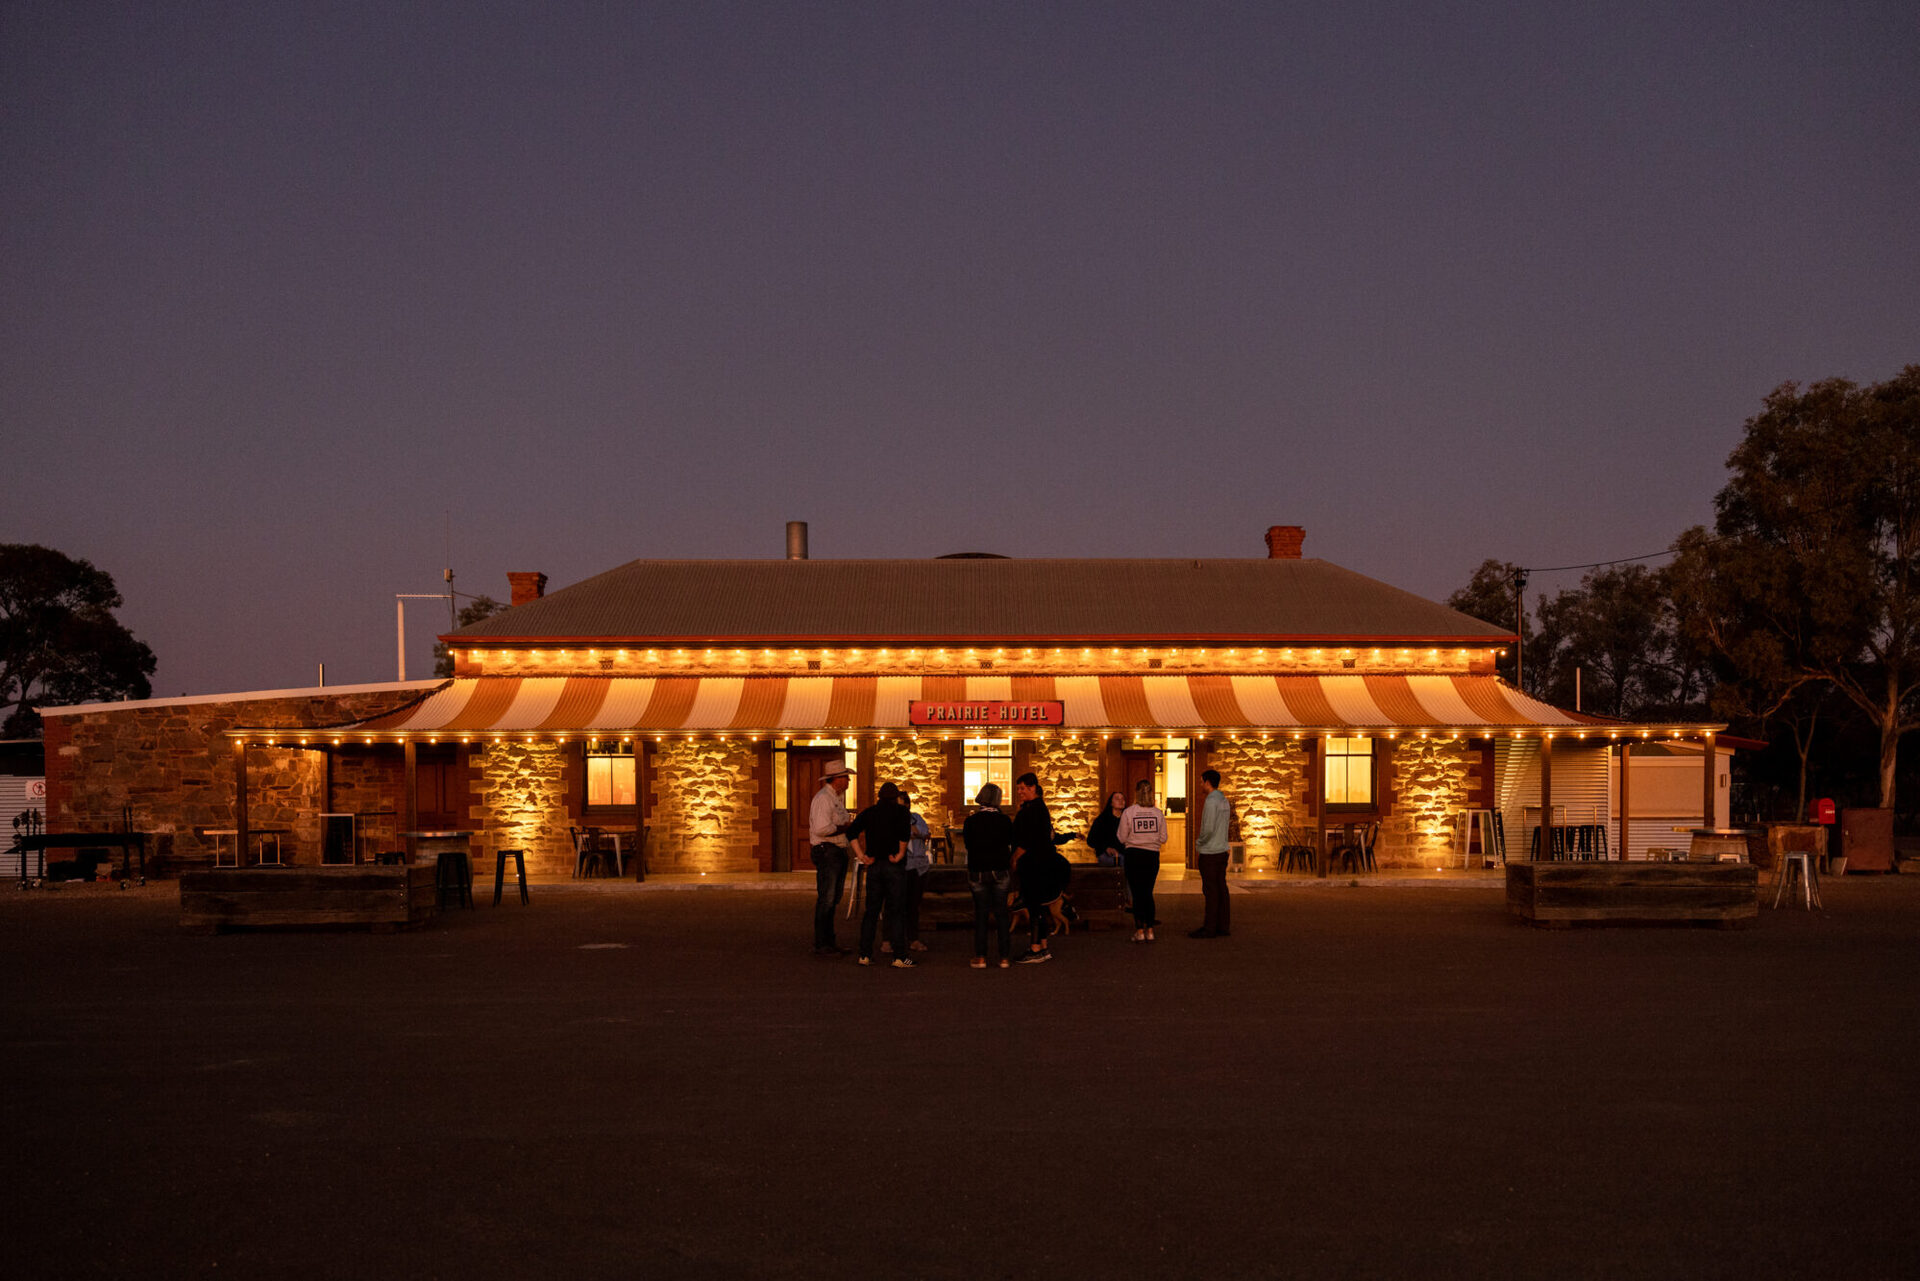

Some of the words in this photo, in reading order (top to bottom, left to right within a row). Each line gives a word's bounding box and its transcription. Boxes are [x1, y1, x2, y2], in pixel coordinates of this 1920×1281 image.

[926, 706, 989, 720] PRAIRIE
[1000, 706, 1048, 720] HOTEL
[1137, 820, 1155, 830] PBP
